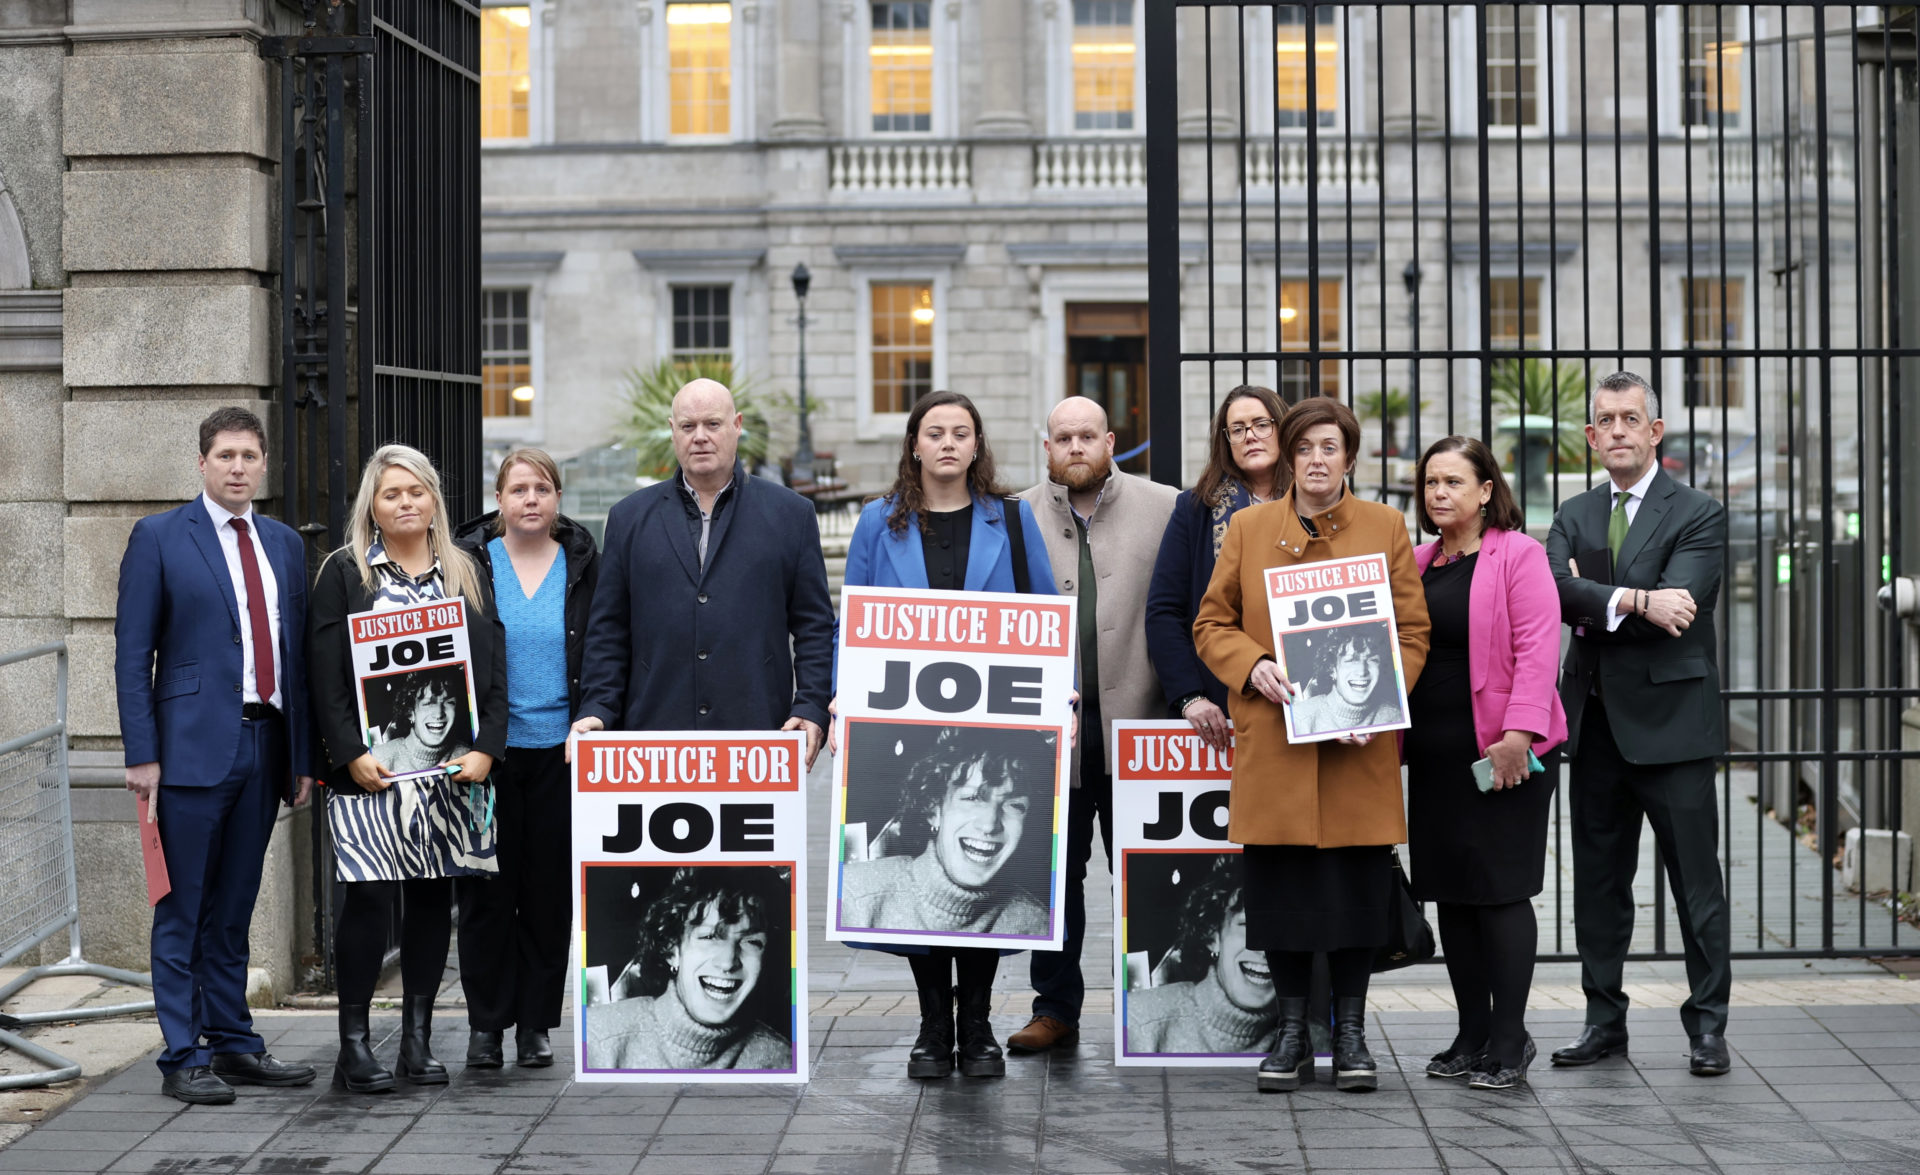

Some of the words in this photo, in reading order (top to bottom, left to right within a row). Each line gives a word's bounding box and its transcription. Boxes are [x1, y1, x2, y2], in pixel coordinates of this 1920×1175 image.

[1275, 566, 1343, 594] JUSTICE
[1346, 561, 1382, 584] FOR
[358, 610, 423, 639] JUSTICE
[426, 605, 460, 628] FOR
[856, 602, 988, 645] JUSTICE
[998, 608, 1061, 648] FOR
[1288, 590, 1377, 627] JOE
[369, 634, 455, 671] JOE
[867, 660, 1043, 716] JOE
[586, 746, 717, 784] JUSTICE
[728, 746, 791, 784] FOR
[1127, 735, 1235, 772] JUSTIC
[602, 802, 774, 854] JOE
[1143, 789, 1231, 841] JO
